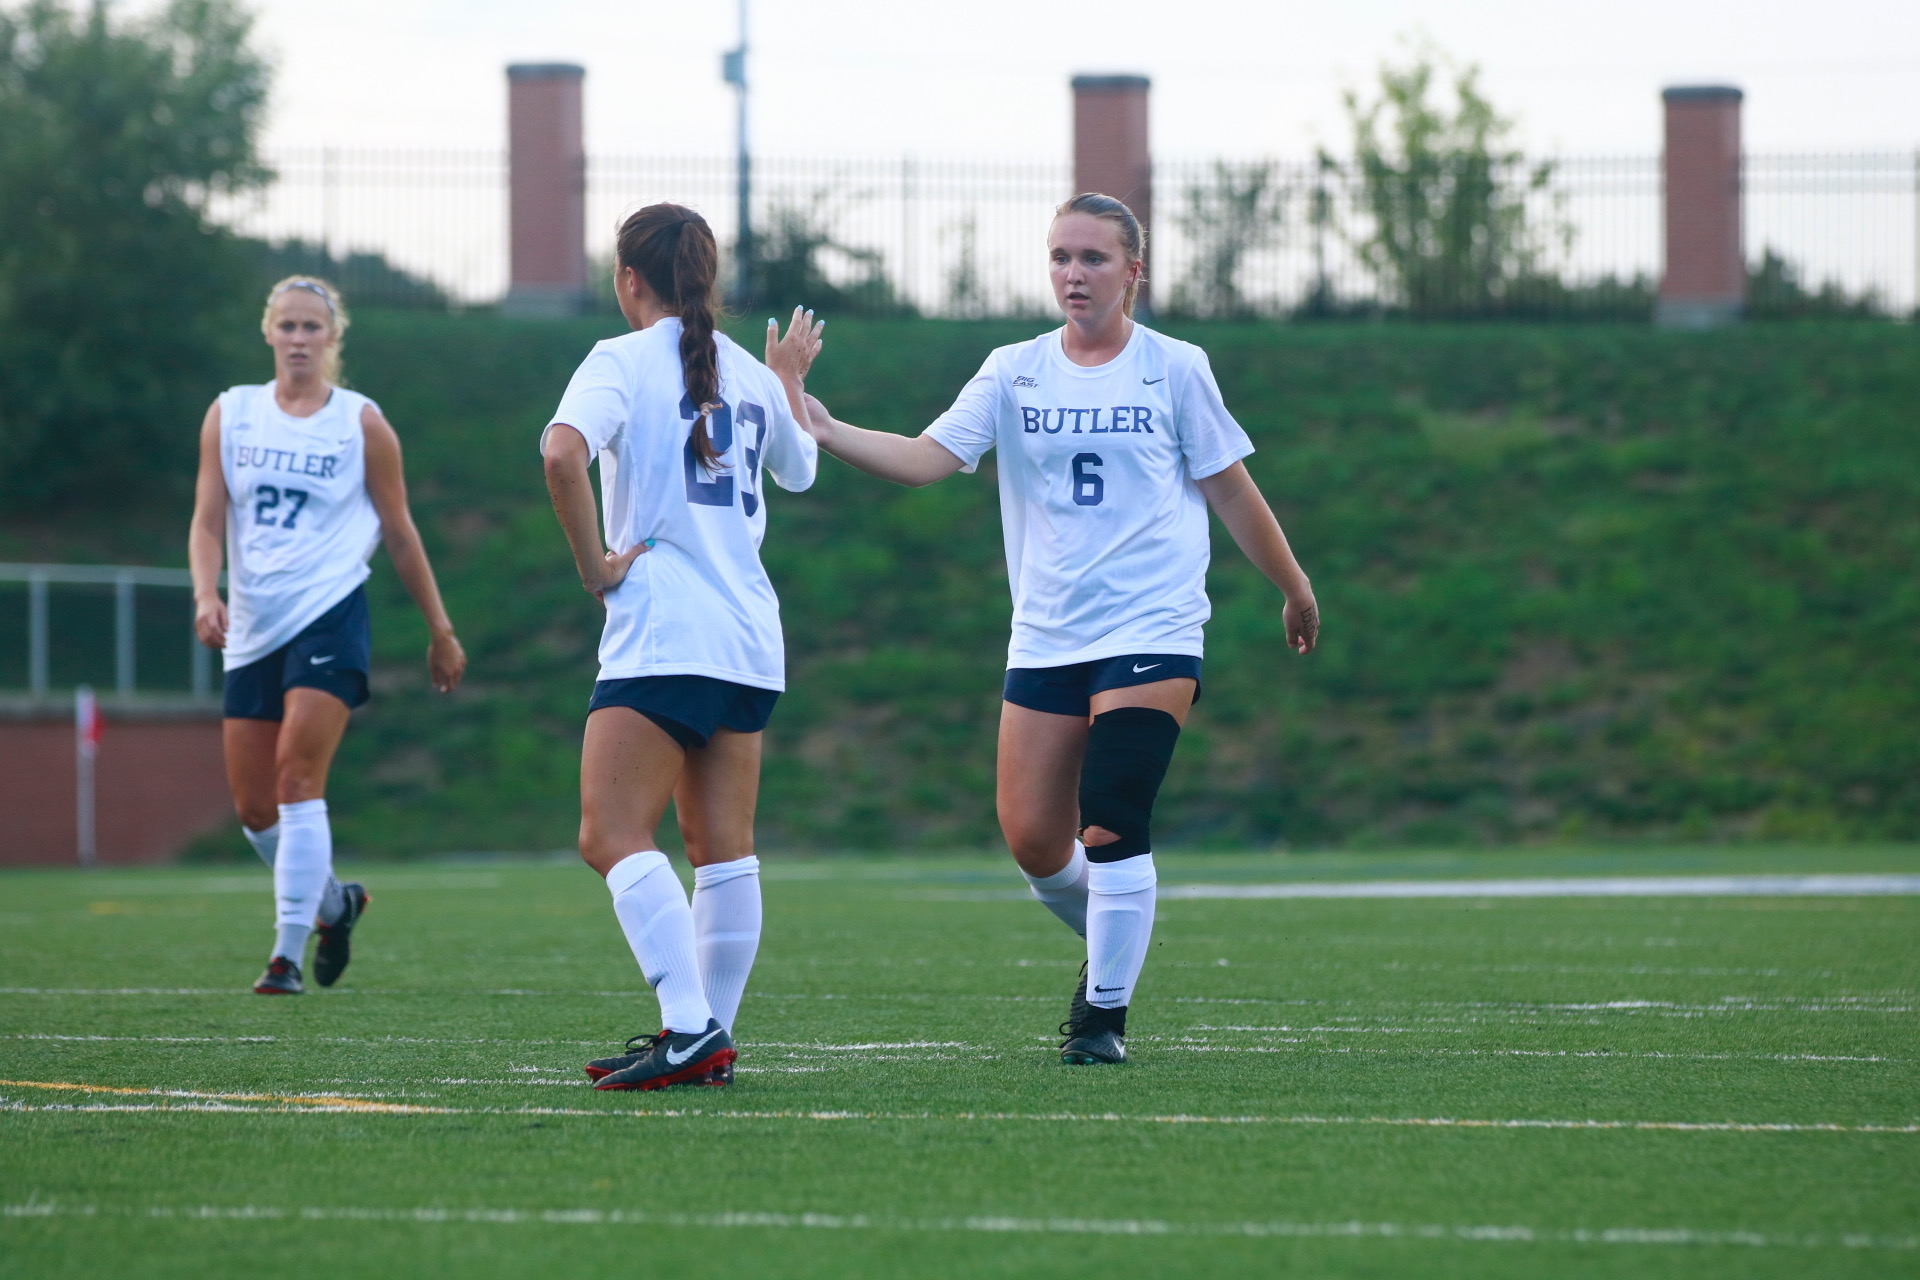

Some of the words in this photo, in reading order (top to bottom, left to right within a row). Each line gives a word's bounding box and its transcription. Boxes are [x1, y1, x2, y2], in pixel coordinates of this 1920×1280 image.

[1012, 379, 1040, 388] EAST
[1016, 375, 1036, 383] BIG
[1020, 406, 1154, 434] BUTLER
[236, 447, 338, 479] BUTLER
[678, 388, 767, 518] 23
[1072, 452, 1104, 507] 6
[255, 484, 309, 529] 27
